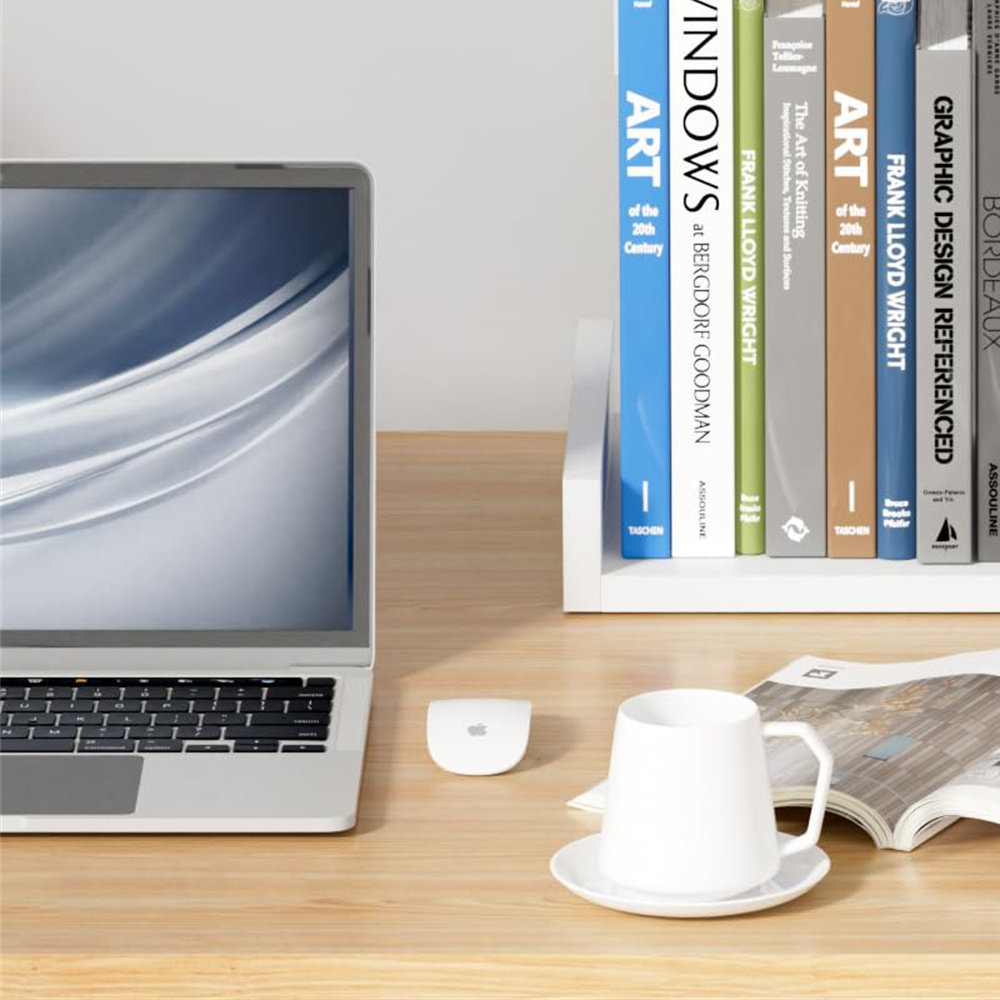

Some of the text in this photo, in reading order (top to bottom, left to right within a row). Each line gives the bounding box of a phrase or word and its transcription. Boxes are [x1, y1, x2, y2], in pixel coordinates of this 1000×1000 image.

[626, 90, 661, 188] ART
[792, 101, 809, 240] The Art of Knitting
[834, 90, 868, 188] ART
[628, 203, 659, 218] of the
[632, 223, 655, 237] 20th
[692, 223, 704, 237] at
[836, 203, 867, 218] of the
[840, 223, 863, 237] 20th
[624, 242, 664, 258] Century
[740, 149, 757, 365] FRANK LLOYD WRIGHT
[831, 242, 871, 258] Century
[886, 154, 907, 371] FRANK LLOYD WRIGHT
[933, 95, 954, 465] GRAPHIC DESIGN REFERENCED
[692, 242, 711, 339] BERGDORF
[693, 344, 711, 444] GOODMAN
[698, 480, 707, 540] ASSOULINE
[834, 525, 870, 536] TASCHEN
[988, 463, 999, 537] ASSOULINE
